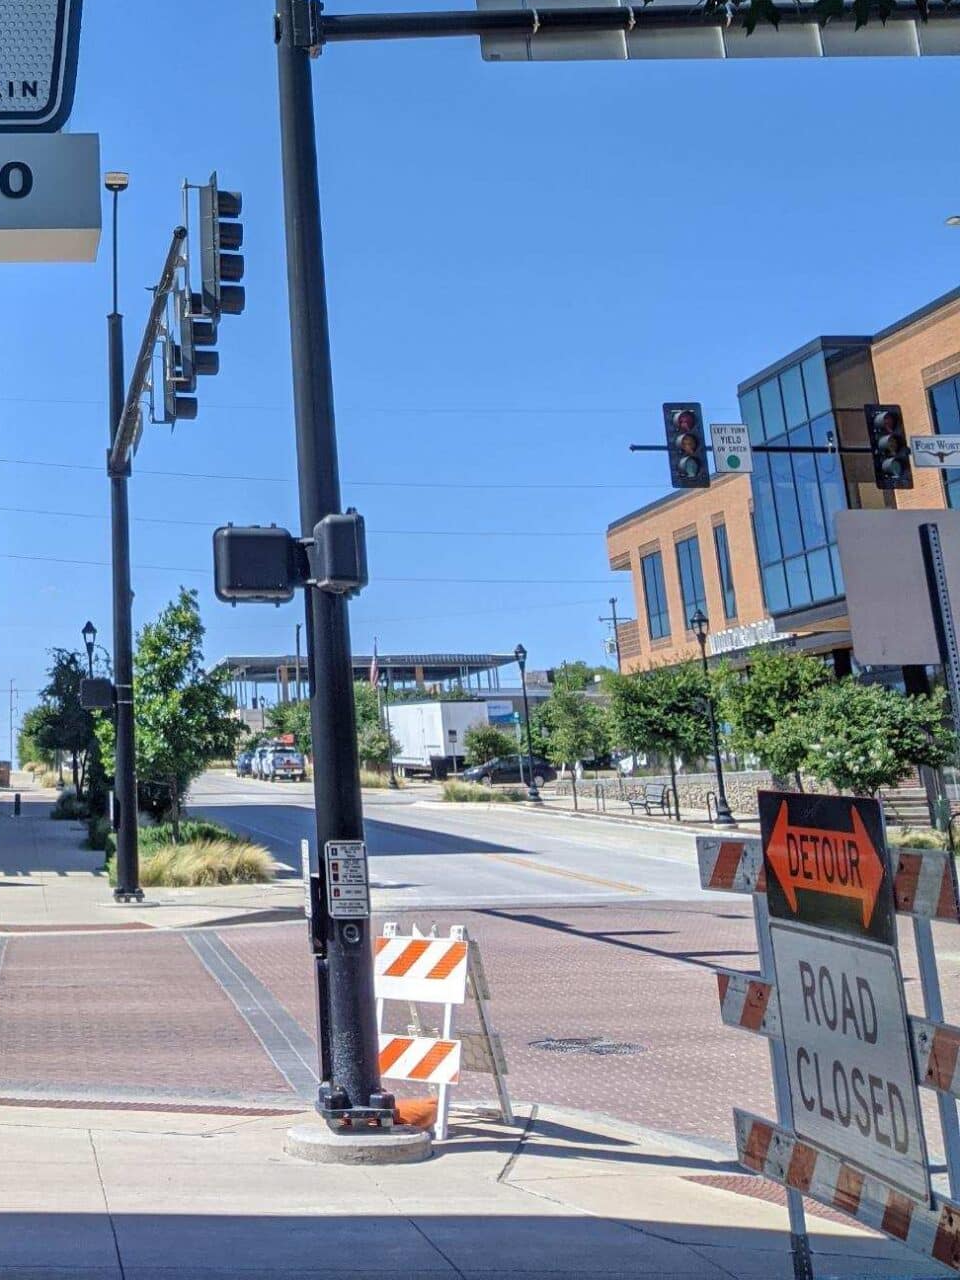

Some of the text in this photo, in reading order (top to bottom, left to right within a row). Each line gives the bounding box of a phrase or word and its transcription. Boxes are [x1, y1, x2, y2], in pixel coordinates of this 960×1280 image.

[720, 435, 742, 445] YIELD
[786, 832, 863, 889] DETOUR
[799, 960, 878, 1045] ROAD
[797, 1046, 909, 1154] CLOSED
